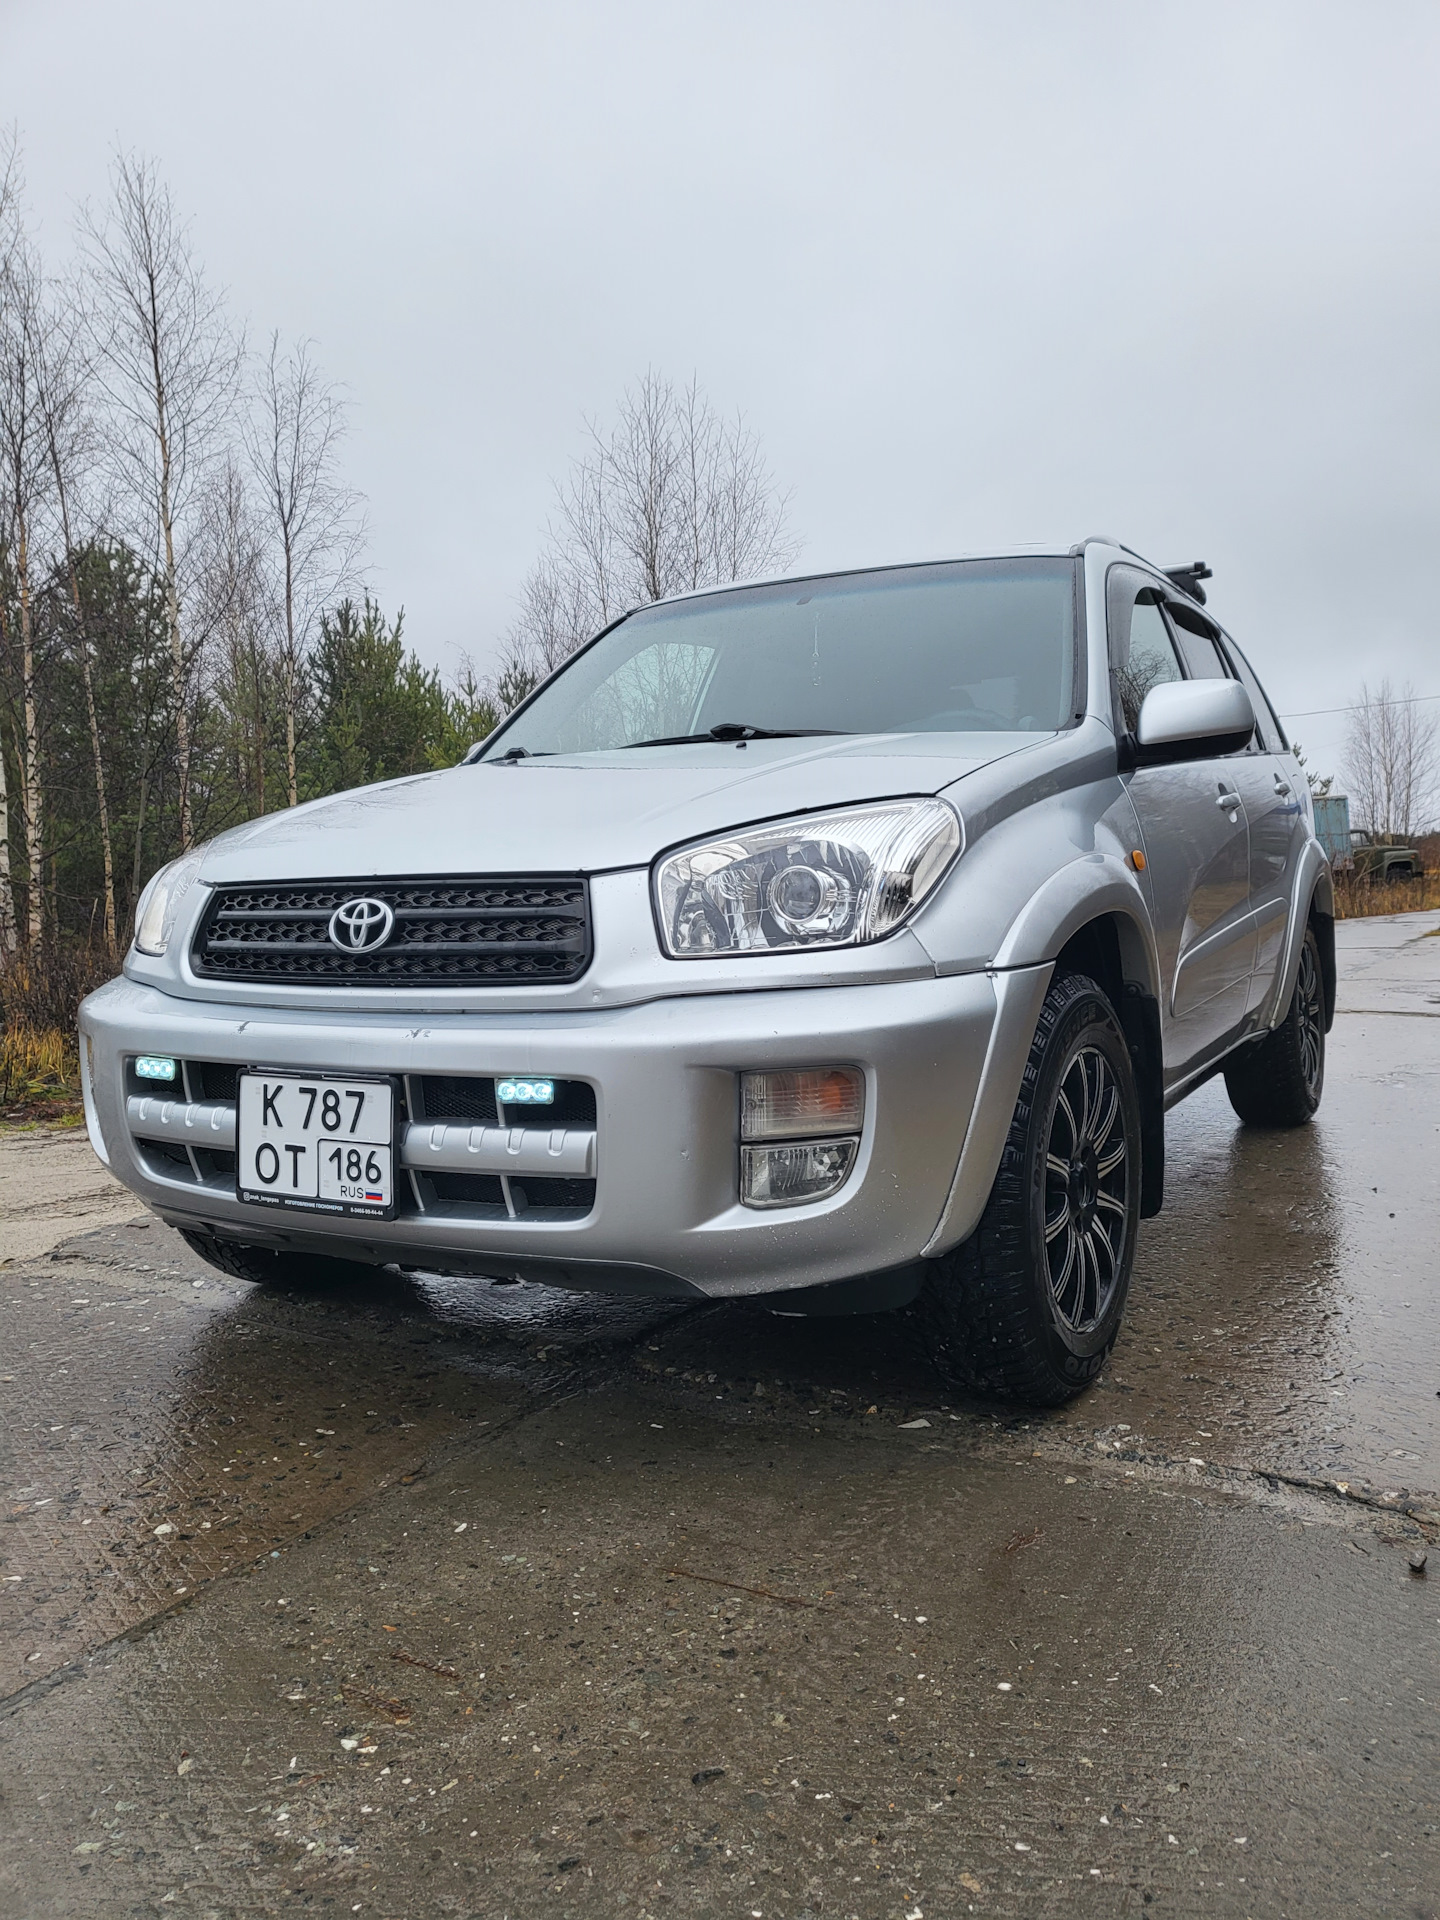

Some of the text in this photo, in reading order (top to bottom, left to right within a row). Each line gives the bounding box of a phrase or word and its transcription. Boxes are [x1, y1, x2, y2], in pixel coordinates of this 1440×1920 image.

[298, 1086, 366, 1134] 787
[328, 1147, 382, 1184] 186
[340, 1185, 364, 1199] RUS
